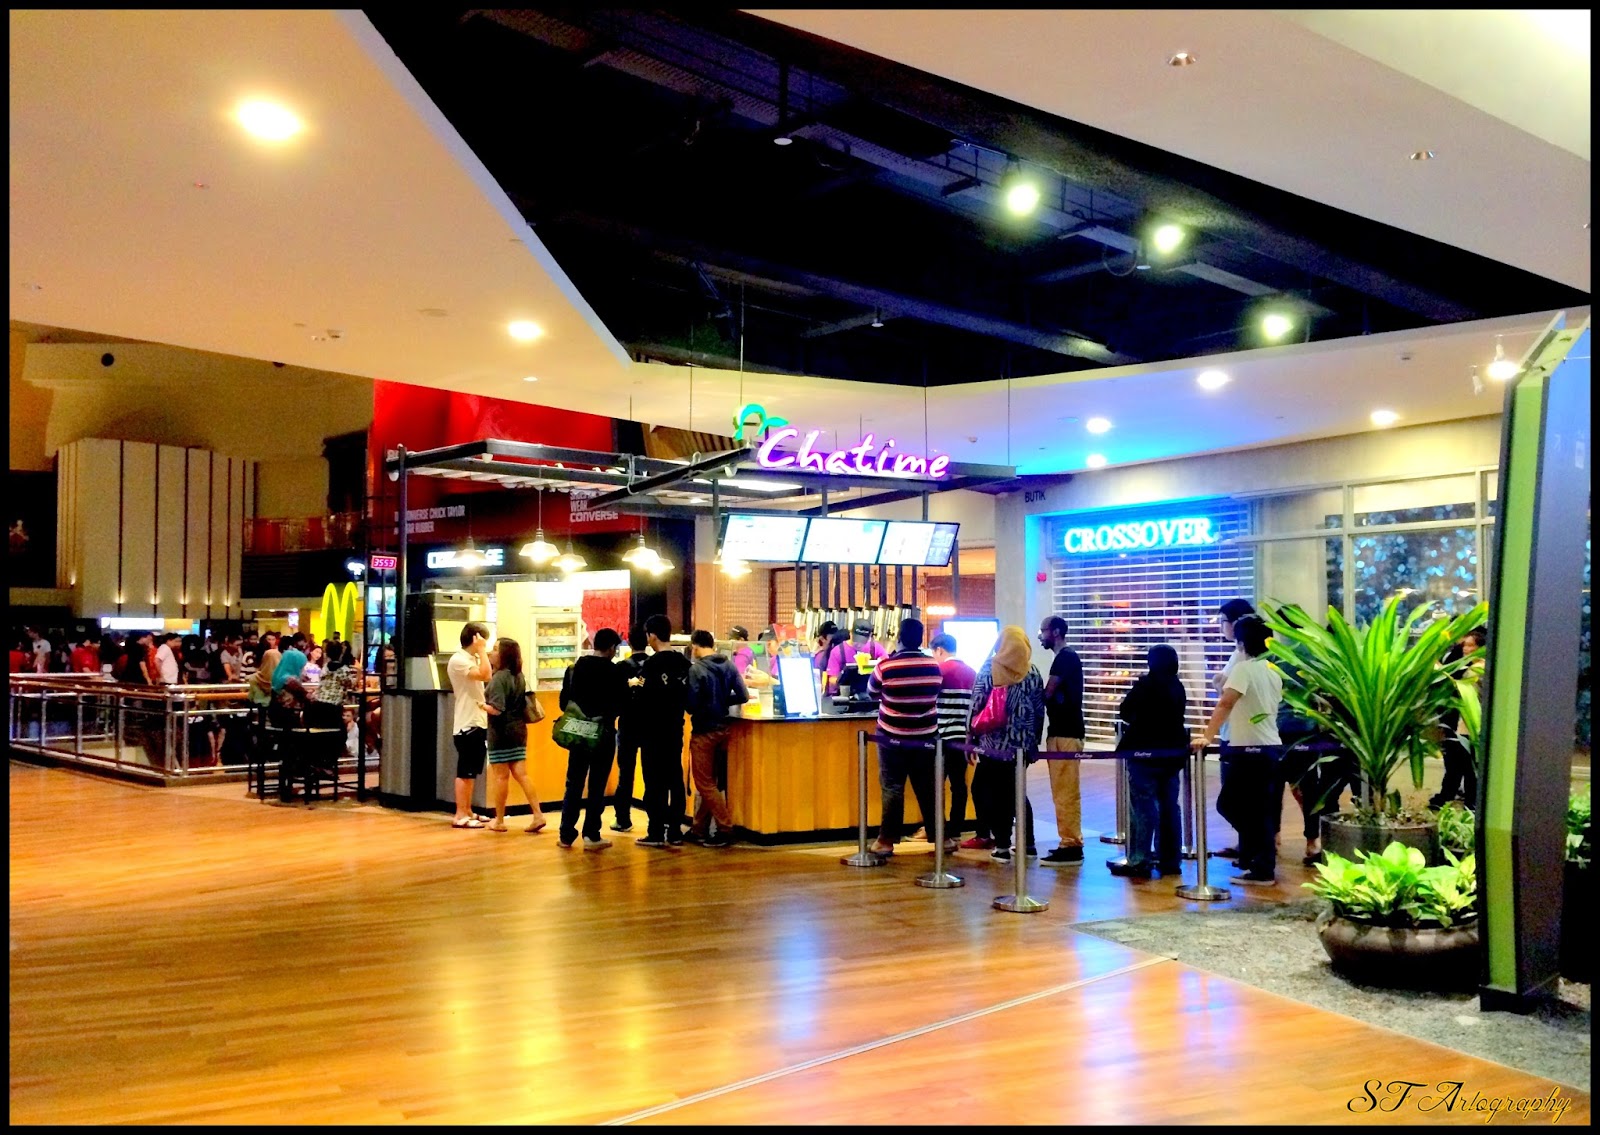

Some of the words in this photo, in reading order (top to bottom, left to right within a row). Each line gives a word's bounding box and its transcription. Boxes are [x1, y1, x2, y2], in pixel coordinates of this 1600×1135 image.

[758, 428, 950, 478] Chatime
[1025, 491, 1046, 503] BUTIK
[570, 511, 619, 523] CONVERSE
[1064, 517, 1219, 553] CROSSOVER
[373, 557, 396, 568] 3553
